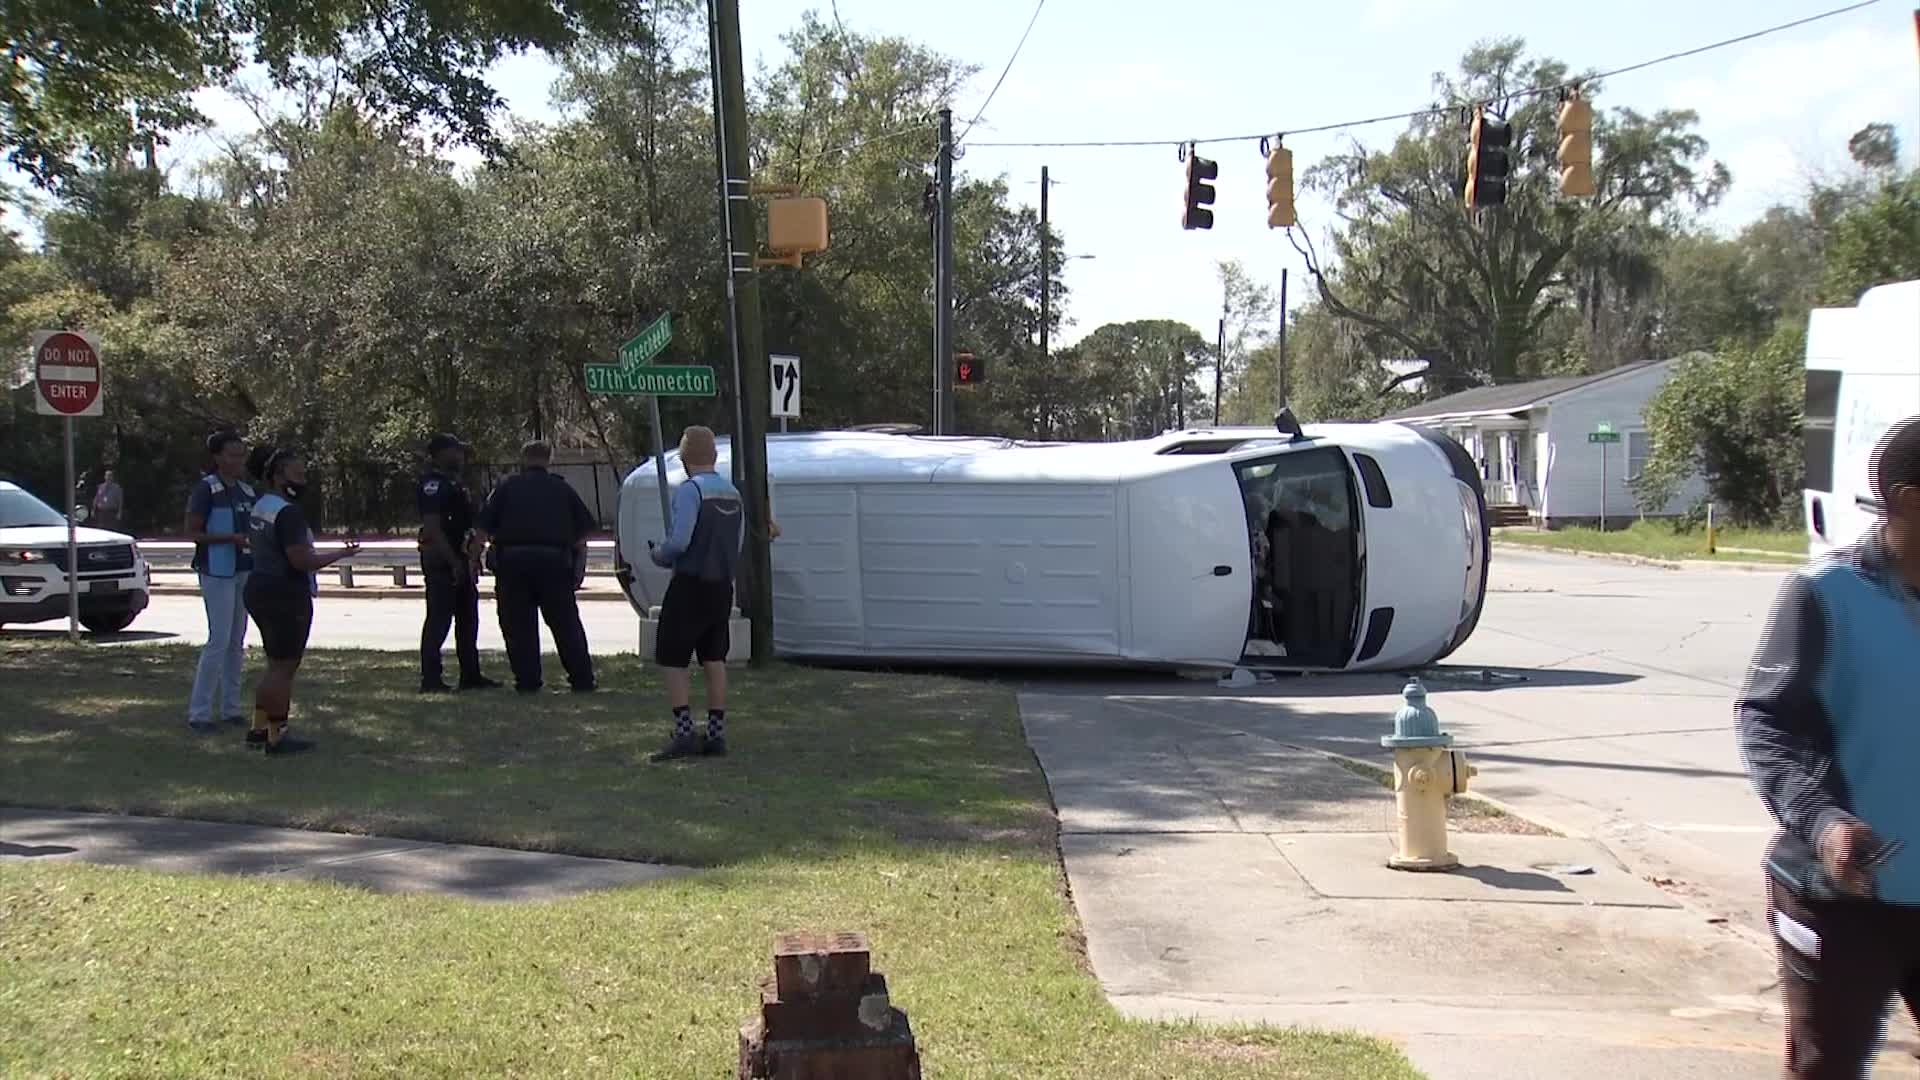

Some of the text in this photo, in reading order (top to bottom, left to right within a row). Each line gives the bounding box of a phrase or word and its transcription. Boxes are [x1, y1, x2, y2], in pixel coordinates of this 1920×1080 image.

[44, 348, 90, 363] DO NOT
[587, 367, 711, 392] 37th Connector
[50, 384, 87, 399] ENTER
